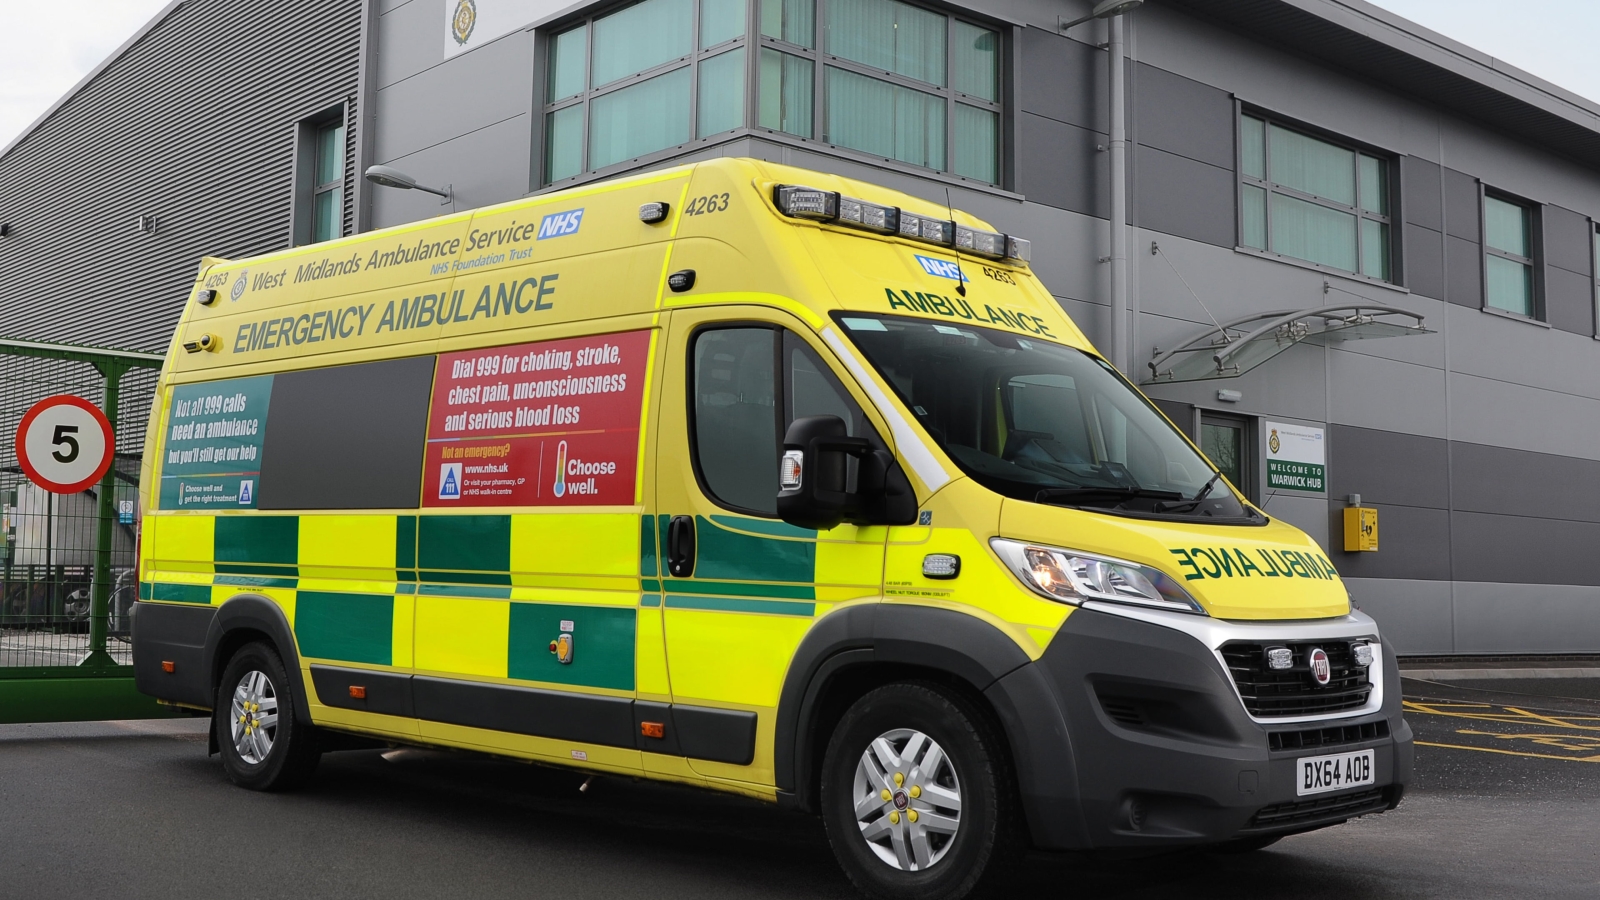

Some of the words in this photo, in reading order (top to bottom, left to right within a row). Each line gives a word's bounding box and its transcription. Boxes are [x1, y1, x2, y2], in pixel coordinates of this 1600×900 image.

[685, 193, 729, 216] 4263
[252, 268, 287, 291] West
[293, 253, 361, 284] Midlands
[364, 237, 460, 272] Ambulance
[466, 220, 534, 251] Service
[539, 210, 582, 237] NHS
[430, 262, 449, 275] NHS
[452, 253, 504, 270] Foundation
[509, 247, 532, 261] Trust
[919, 257, 964, 279] NHS
[983, 266, 1016, 285] 4263
[205, 272, 229, 288] 4263
[233, 303, 374, 353] EMERGENCY
[375, 274, 560, 333] AMBULANCE
[885, 288, 1057, 339] AMBULANCE
[452, 358, 475, 379] Dial
[477, 355, 500, 376] 999
[501, 355, 519, 374] for
[520, 349, 573, 372] choking,
[576, 344, 621, 367] stroke,
[448, 385, 481, 405] chest
[482, 382, 510, 404] pain,
[513, 373, 626, 400] unconsciousness
[175, 400, 191, 417] Not
[191, 397, 204, 416] all
[204, 395, 222, 415] 999
[223, 393, 246, 413] calls
[445, 411, 467, 431] and
[468, 409, 512, 430] serious
[514, 405, 551, 427] blood
[552, 404, 579, 424] loss
[172, 421, 194, 440] need
[194, 422, 206, 438] an
[207, 418, 258, 438] ambulance
[52, 425, 79, 463] 5
[168, 450, 180, 463] but
[180, 447, 199, 464] you'll
[199, 446, 214, 462] still
[214, 447, 226, 463] get
[226, 448, 239, 460] our
[240, 445, 256, 461] help
[442, 446, 453, 459] Not
[453, 448, 464, 458] an
[464, 443, 510, 459] emergency?
[465, 463, 508, 474] www.nhs.uk
[568, 459, 616, 475] Choose
[1270, 463, 1307, 474] WELCOME
[446, 483, 455, 493] 111
[492, 478, 517, 487] pharmacy,
[568, 478, 598, 494] well.
[1271, 474, 1305, 487] WARWICK
[1307, 478, 1321, 488] HUB
[1304, 757, 1341, 789] DX64
[1345, 755, 1370, 784] AOB
